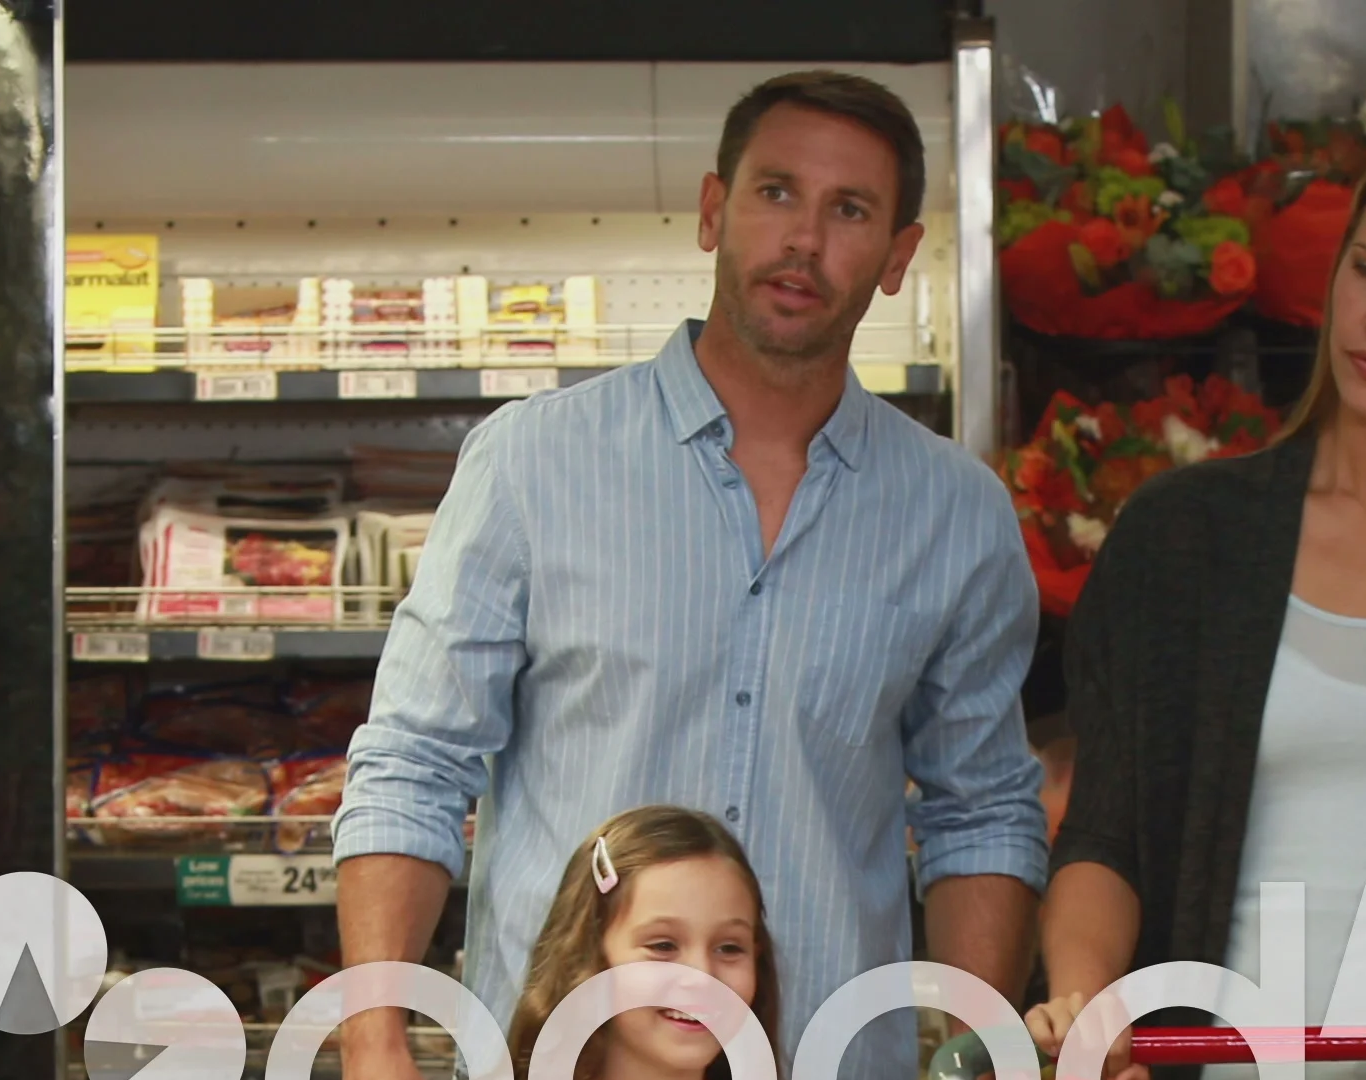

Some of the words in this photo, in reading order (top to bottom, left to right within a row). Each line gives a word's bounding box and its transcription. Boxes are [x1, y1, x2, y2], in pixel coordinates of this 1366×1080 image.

[65, 270, 150, 287] armalat
[188, 860, 220, 873] Low
[182, 876, 225, 888] prices
[283, 867, 317, 894] 24
